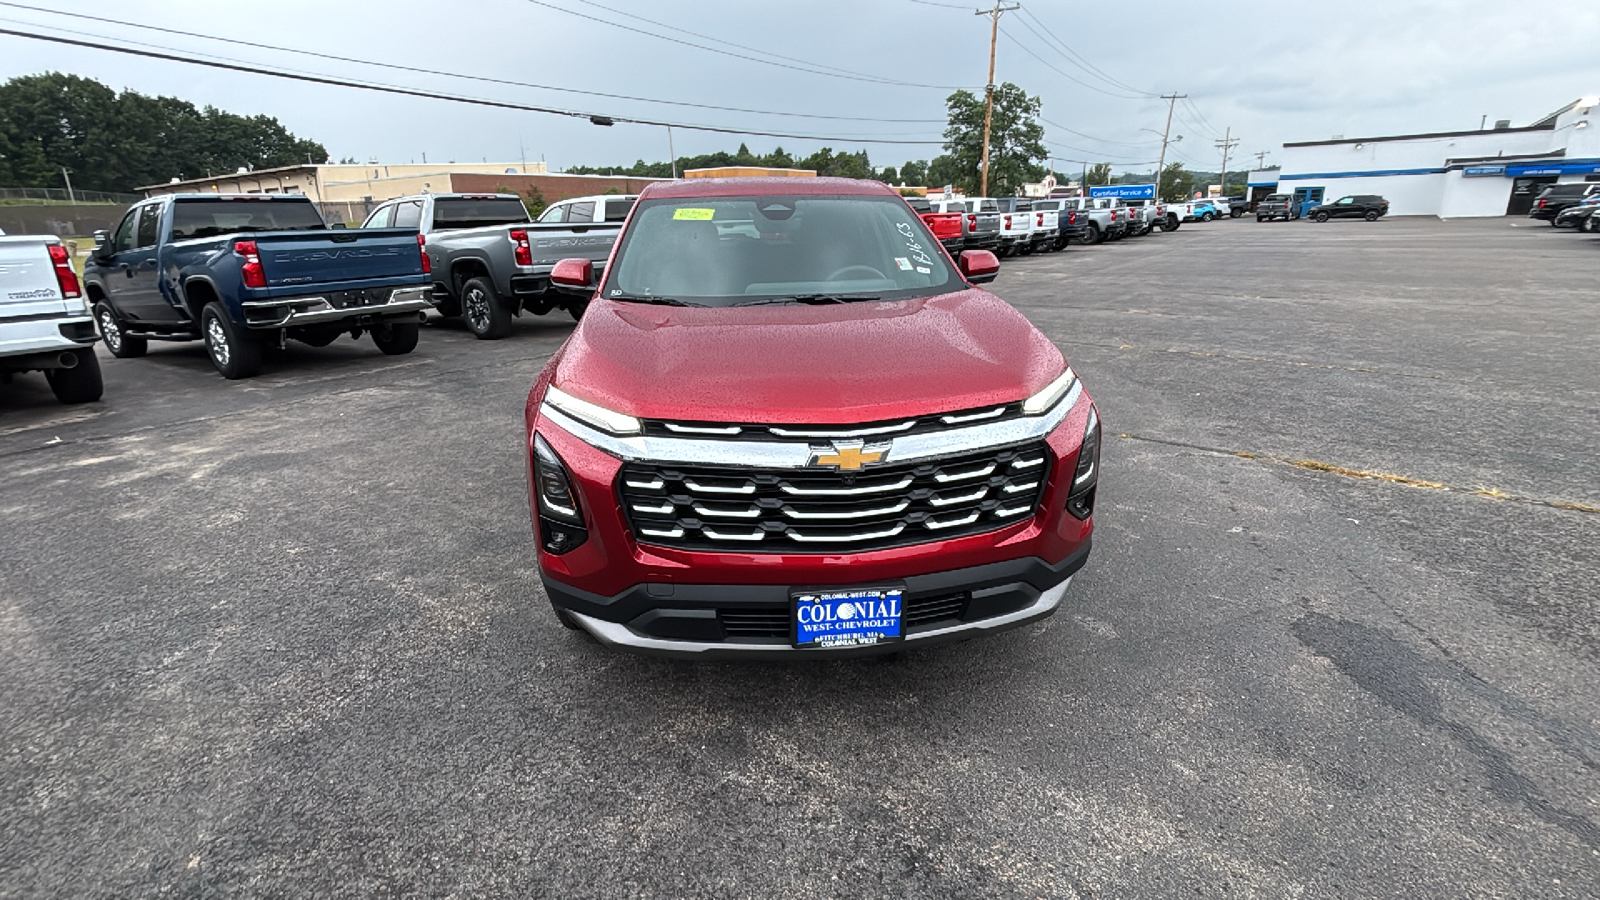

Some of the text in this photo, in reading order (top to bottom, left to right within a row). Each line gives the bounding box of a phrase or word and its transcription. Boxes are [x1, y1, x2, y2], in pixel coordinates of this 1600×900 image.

[1093, 189, 1119, 198] Certified
[538, 238, 615, 247] CHEVROLE
[274, 246, 411, 263] CHEVROLET
[820, 591, 880, 600] COLONIAL-WEST.COM
[797, 600, 901, 623] COLONIAL
[835, 619, 896, 629] CHEVROLET
